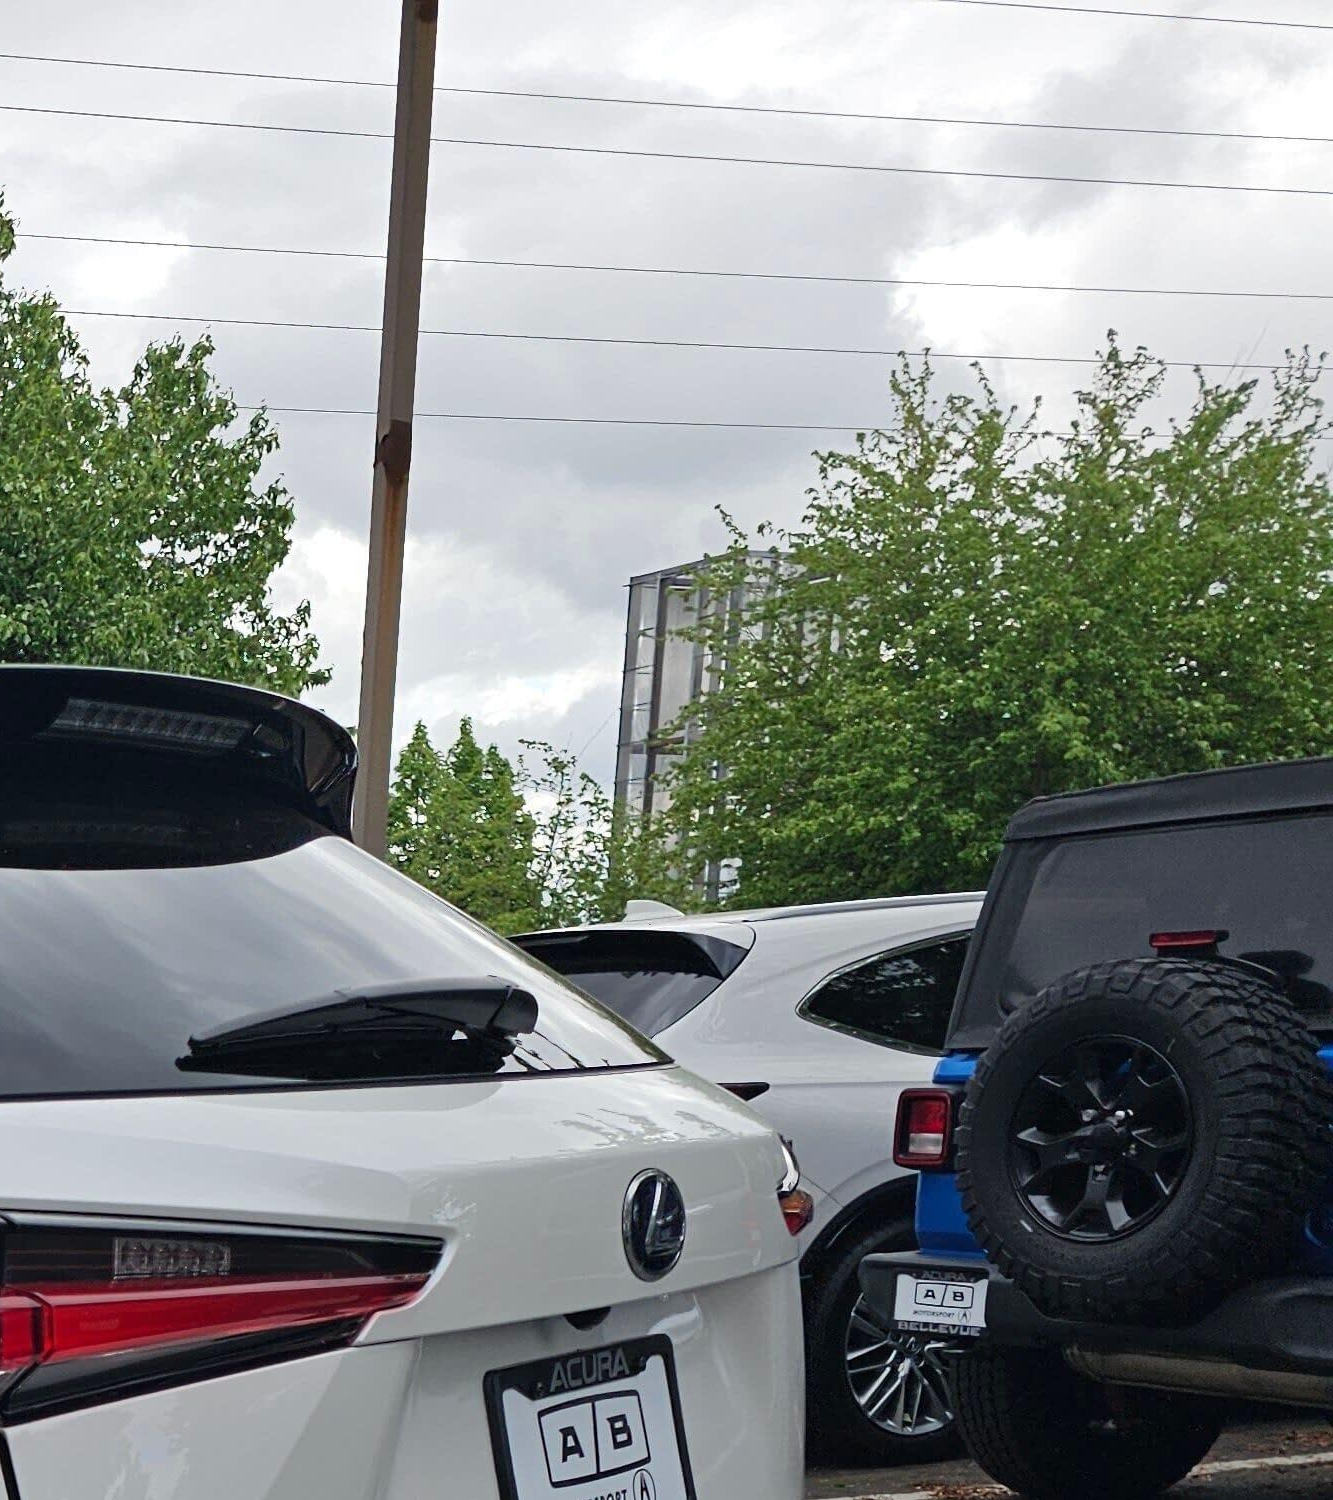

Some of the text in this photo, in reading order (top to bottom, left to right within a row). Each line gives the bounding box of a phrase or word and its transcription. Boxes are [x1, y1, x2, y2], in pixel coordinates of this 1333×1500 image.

[921, 1270, 966, 1282] ACURA
[923, 1289, 965, 1302] A B
[912, 1309, 955, 1318] MOTORSPORT
[897, 1321, 981, 1337] BELLEVUE
[549, 1348, 630, 1393] ACURA
[558, 1413, 633, 1463] A B
